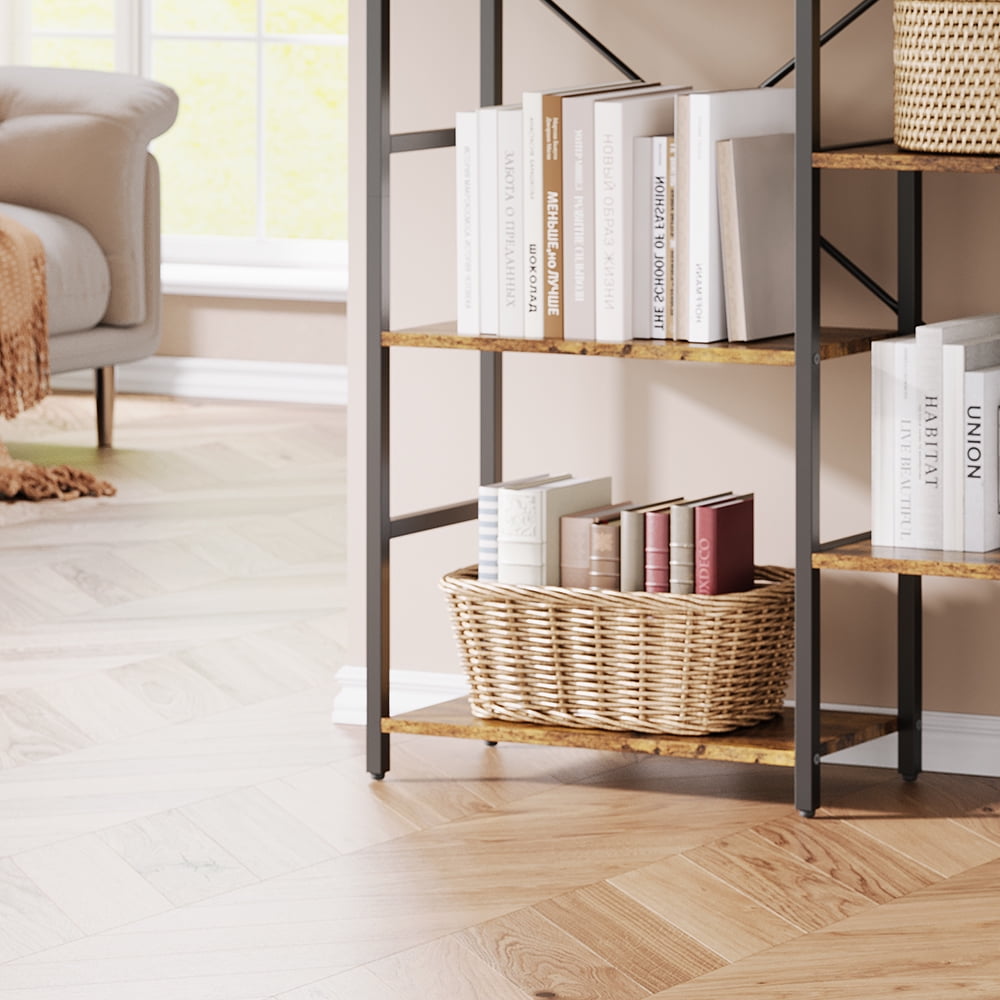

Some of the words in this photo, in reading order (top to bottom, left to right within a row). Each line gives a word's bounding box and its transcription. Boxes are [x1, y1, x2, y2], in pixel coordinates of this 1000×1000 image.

[504, 151, 515, 201] ЗАБОТА
[602, 134, 616, 191] НОВЫЙ
[602, 197, 616, 247] ОБРАЗ
[505, 221, 515, 308] ПРЕДАННЫХ
[529, 243, 538, 313] ШОКОЛАД
[547, 269, 560, 317] ЛУЧШЕ
[602, 251, 616, 311] ЖИЗНИ
[901, 420, 911, 450] LIVE
[924, 396, 938, 488] HABITAT
[967, 405, 982, 480] UNION
[901, 456, 911, 536] BEAUTIFUL
